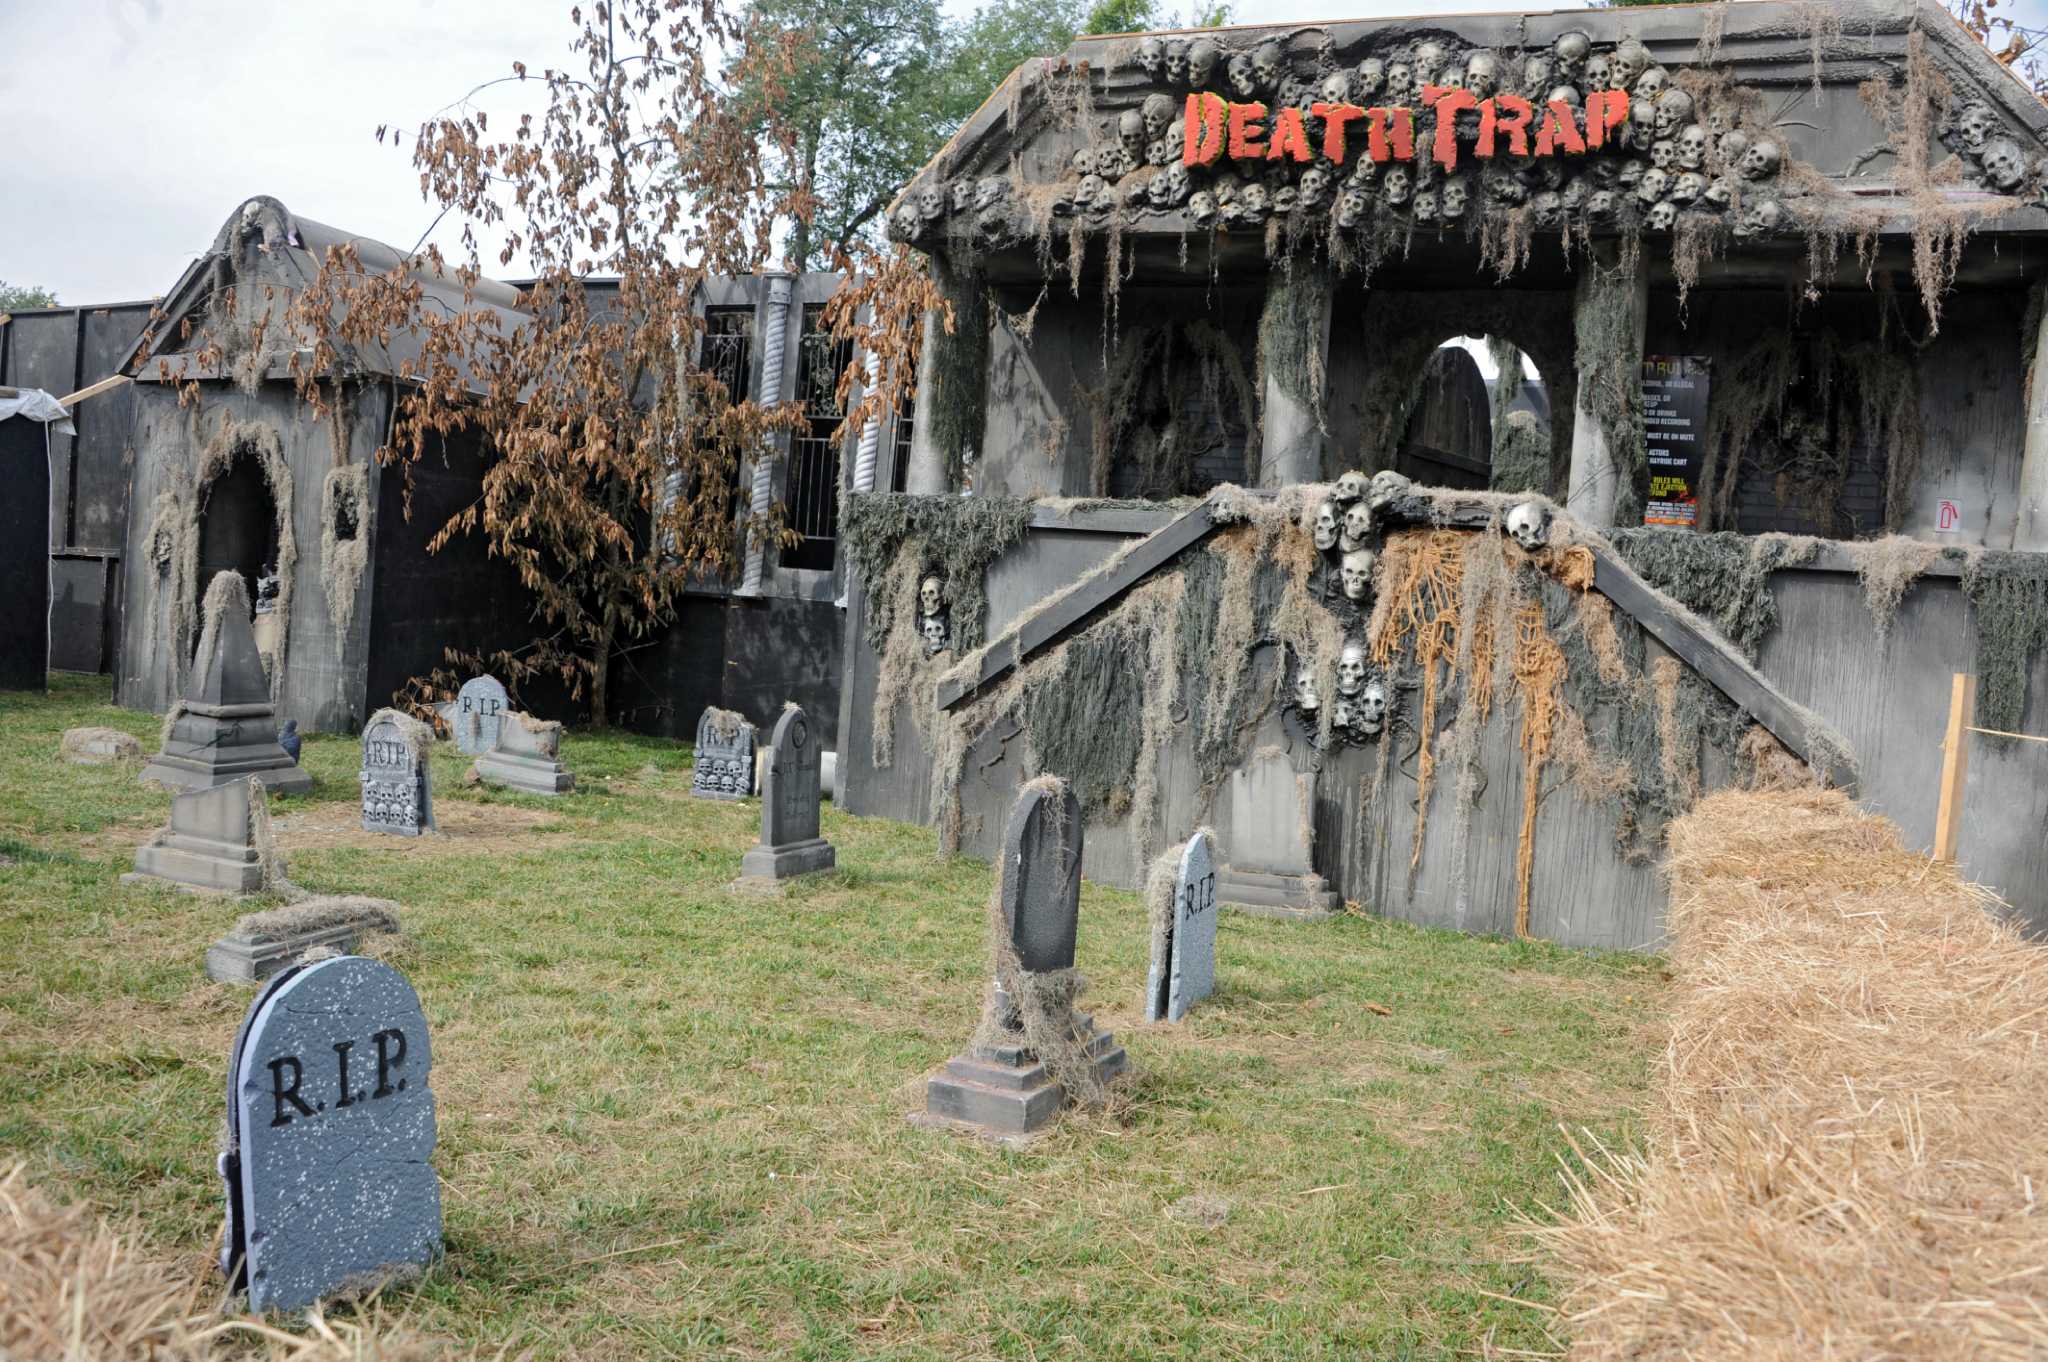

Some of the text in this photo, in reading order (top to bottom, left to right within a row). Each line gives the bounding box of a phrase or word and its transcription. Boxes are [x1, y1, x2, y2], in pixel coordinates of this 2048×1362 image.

[1661, 418, 1691, 426] RECORDING
[1680, 433, 1695, 441] MUTE
[1648, 449, 1670, 457] ACTORS
[1649, 457, 1688, 466] HAYRIDE CART
[267, 1028, 407, 1127] R.I.P.
